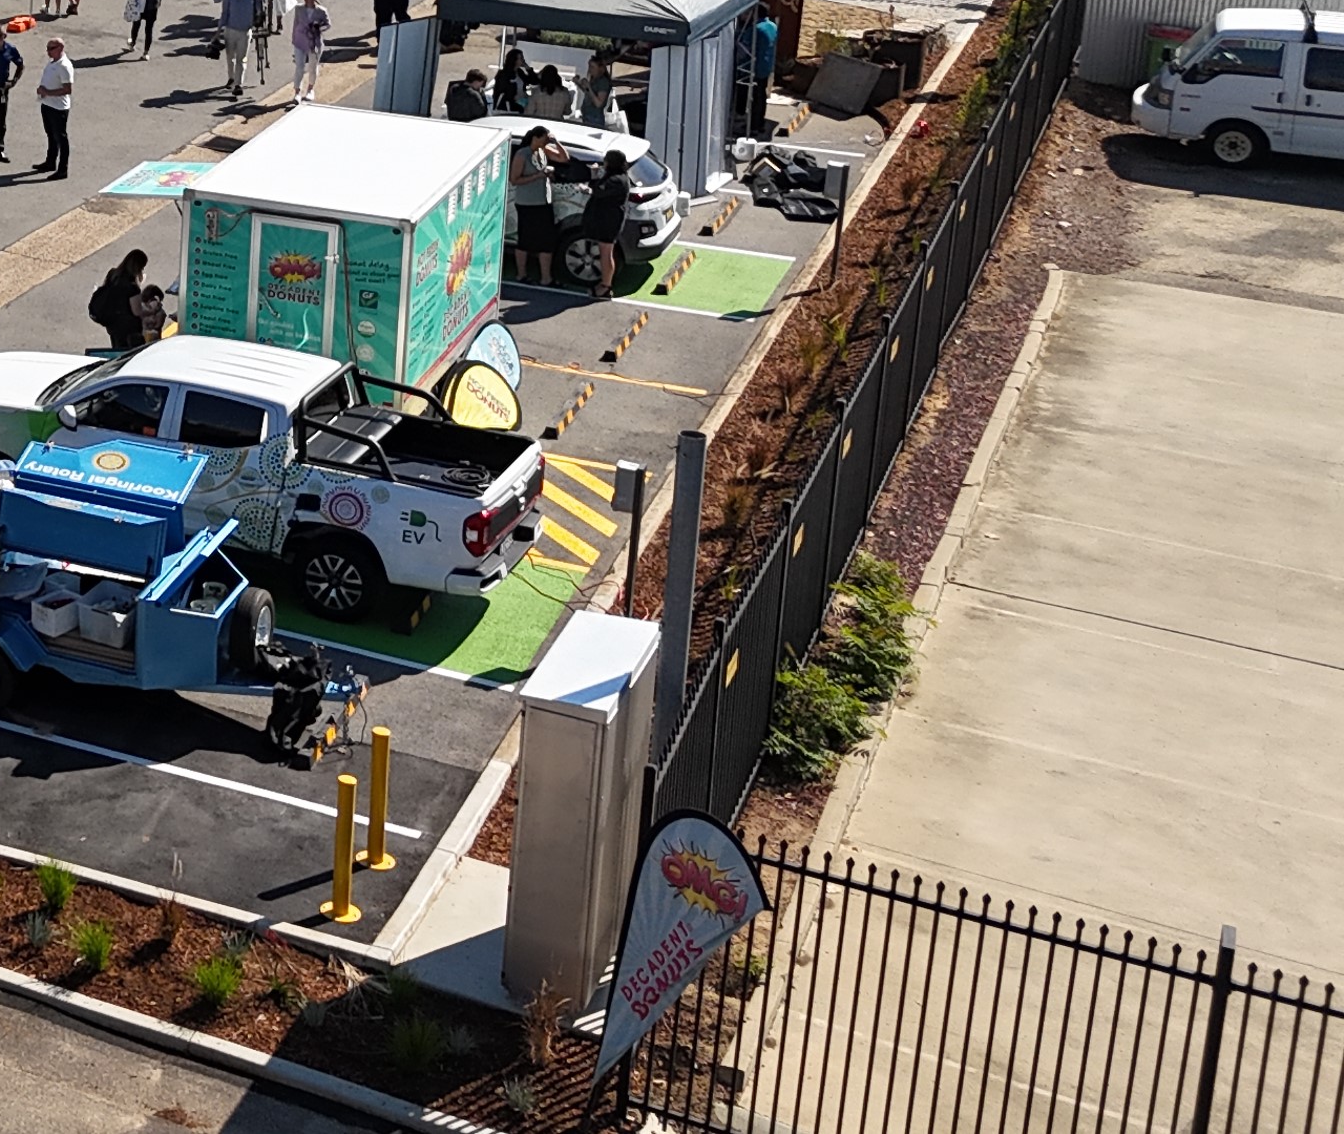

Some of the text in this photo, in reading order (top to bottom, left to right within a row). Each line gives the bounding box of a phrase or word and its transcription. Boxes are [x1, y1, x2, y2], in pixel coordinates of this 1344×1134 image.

[268, 289, 320, 306] DONUTS
[466, 381, 509, 423] DONUTS
[468, 374, 485, 392] HOT
[24, 460, 180, 501] Kooringal Rotary
[402, 530, 426, 545] EV
[662, 850, 748, 924] OMG!
[621, 919, 690, 1002] DECADENT
[631, 939, 703, 1020] DONUTS
